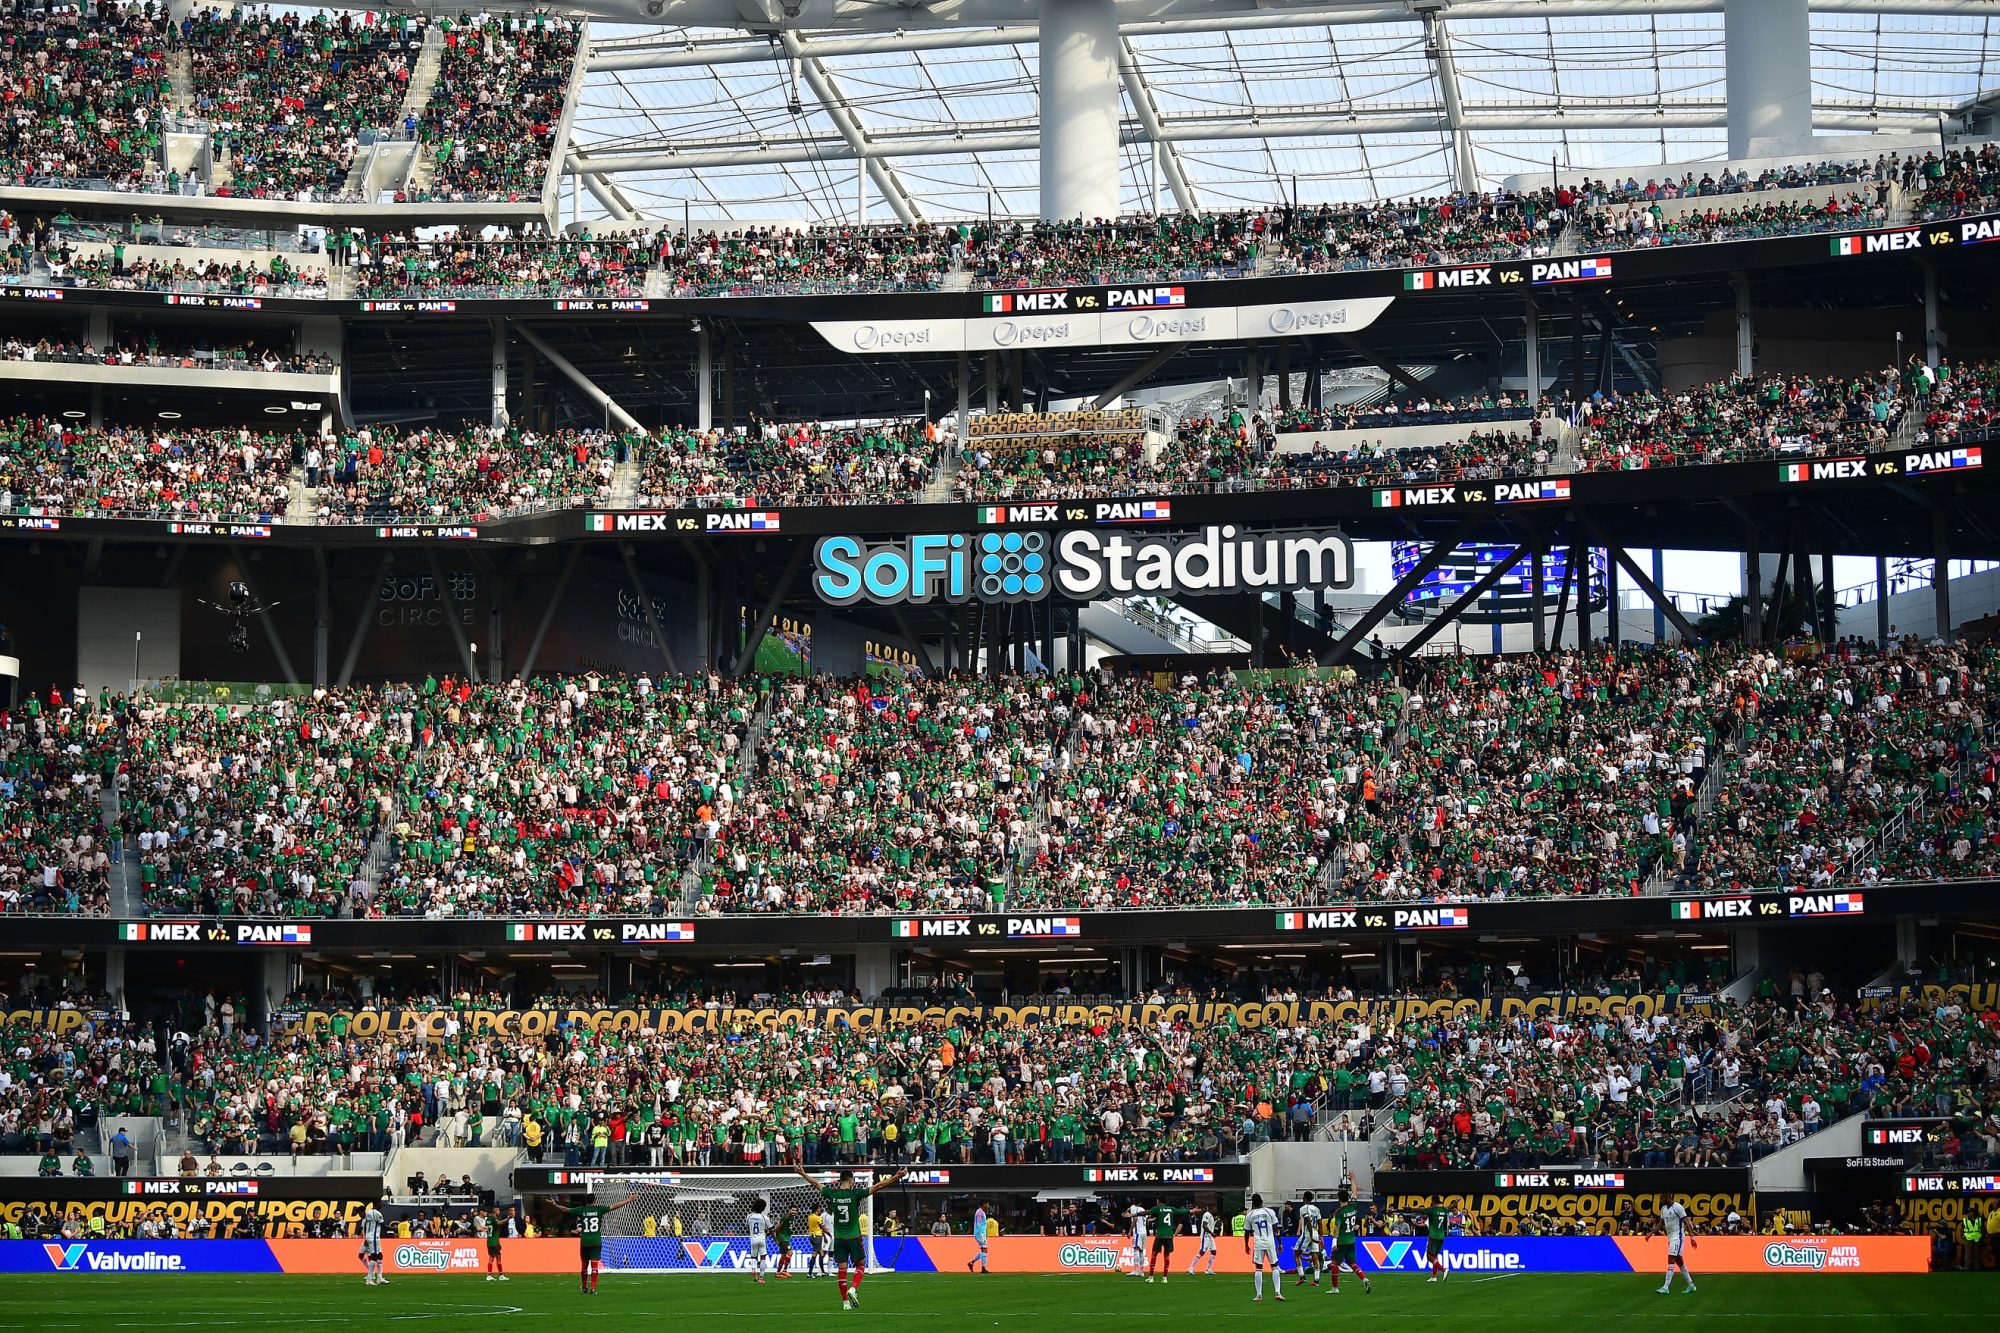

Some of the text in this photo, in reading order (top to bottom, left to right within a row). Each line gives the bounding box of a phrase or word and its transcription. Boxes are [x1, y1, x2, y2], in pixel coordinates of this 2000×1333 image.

[1867, 231, 1921, 252] MEX
[1930, 232, 1953, 244] vs.
[1439, 261, 1580, 288] MEX vs. PAN
[24, 289, 47, 298] PAN
[180, 296, 205, 306] MEX
[223, 298, 246, 308] PAN
[1016, 289, 1154, 311] MEX vs. PAN
[375, 303, 400, 311] MEX
[418, 302, 440, 311] PAN
[569, 301, 593, 310] MEX
[612, 301, 634, 310] PAN
[1156, 317, 1206, 336] pepsi
[1296, 308, 1348, 329] pepsi
[881, 328, 931, 346] pepsi
[1020, 323, 1069, 342] pepsi
[1814, 452, 1951, 480] MEX vs. PAN
[1406, 483, 1539, 506] MEX vs. PAN
[617, 513, 751, 531] MEX vs. PAN
[1010, 503, 1141, 523] MEX vs. PAN
[18, 518, 43, 528] PAN
[184, 523, 211, 534] MEX
[231, 525, 256, 536] PAN
[392, 527, 418, 537] MEX
[438, 527, 463, 537] PAN
[819, 525, 1347, 598] SoFi Stadium
[1705, 896, 1834, 918] MEX vs. PAN
[923, 919, 1051, 937] MEX vs. PAN
[1308, 910, 1440, 929] MEX vs. PAN
[151, 924, 201, 941] MEX
[237, 925, 282, 942] PAN
[538, 923, 667, 941] MEX vs. PAN
[1889, 1129, 1922, 1143] MEX
[1846, 1157, 1904, 1167] SoFi Stadium
[1105, 1169, 1138, 1181] MEX
[1164, 1169, 1194, 1181] PAN
[1516, 1175, 1550, 1187] MEX
[1574, 1174, 1605, 1187] PAN
[1918, 1178, 1943, 1191] MEX
[1963, 1177, 1986, 1190] PAN
[145, 1182, 180, 1194] MEX
[206, 1181, 238, 1194] PAN
[837, 1205, 850, 1223] 3
[1163, 1212, 1171, 1226] 4
[1438, 1216, 1445, 1229] 7
[582, 1217, 600, 1232] 18
[753, 1221, 760, 1236] 8
[87, 1251, 182, 1270] Valvoline
[396, 1246, 450, 1270] O'Reilly
[453, 1248, 477, 1258] AUTO
[1061, 1244, 1117, 1269] O'Reilly
[1765, 1243, 1826, 1269] O'Reilly
[1831, 1246, 1857, 1257] AUTO
[451, 1258, 479, 1268] PARTS
[1828, 1257, 1860, 1267] PARTS
